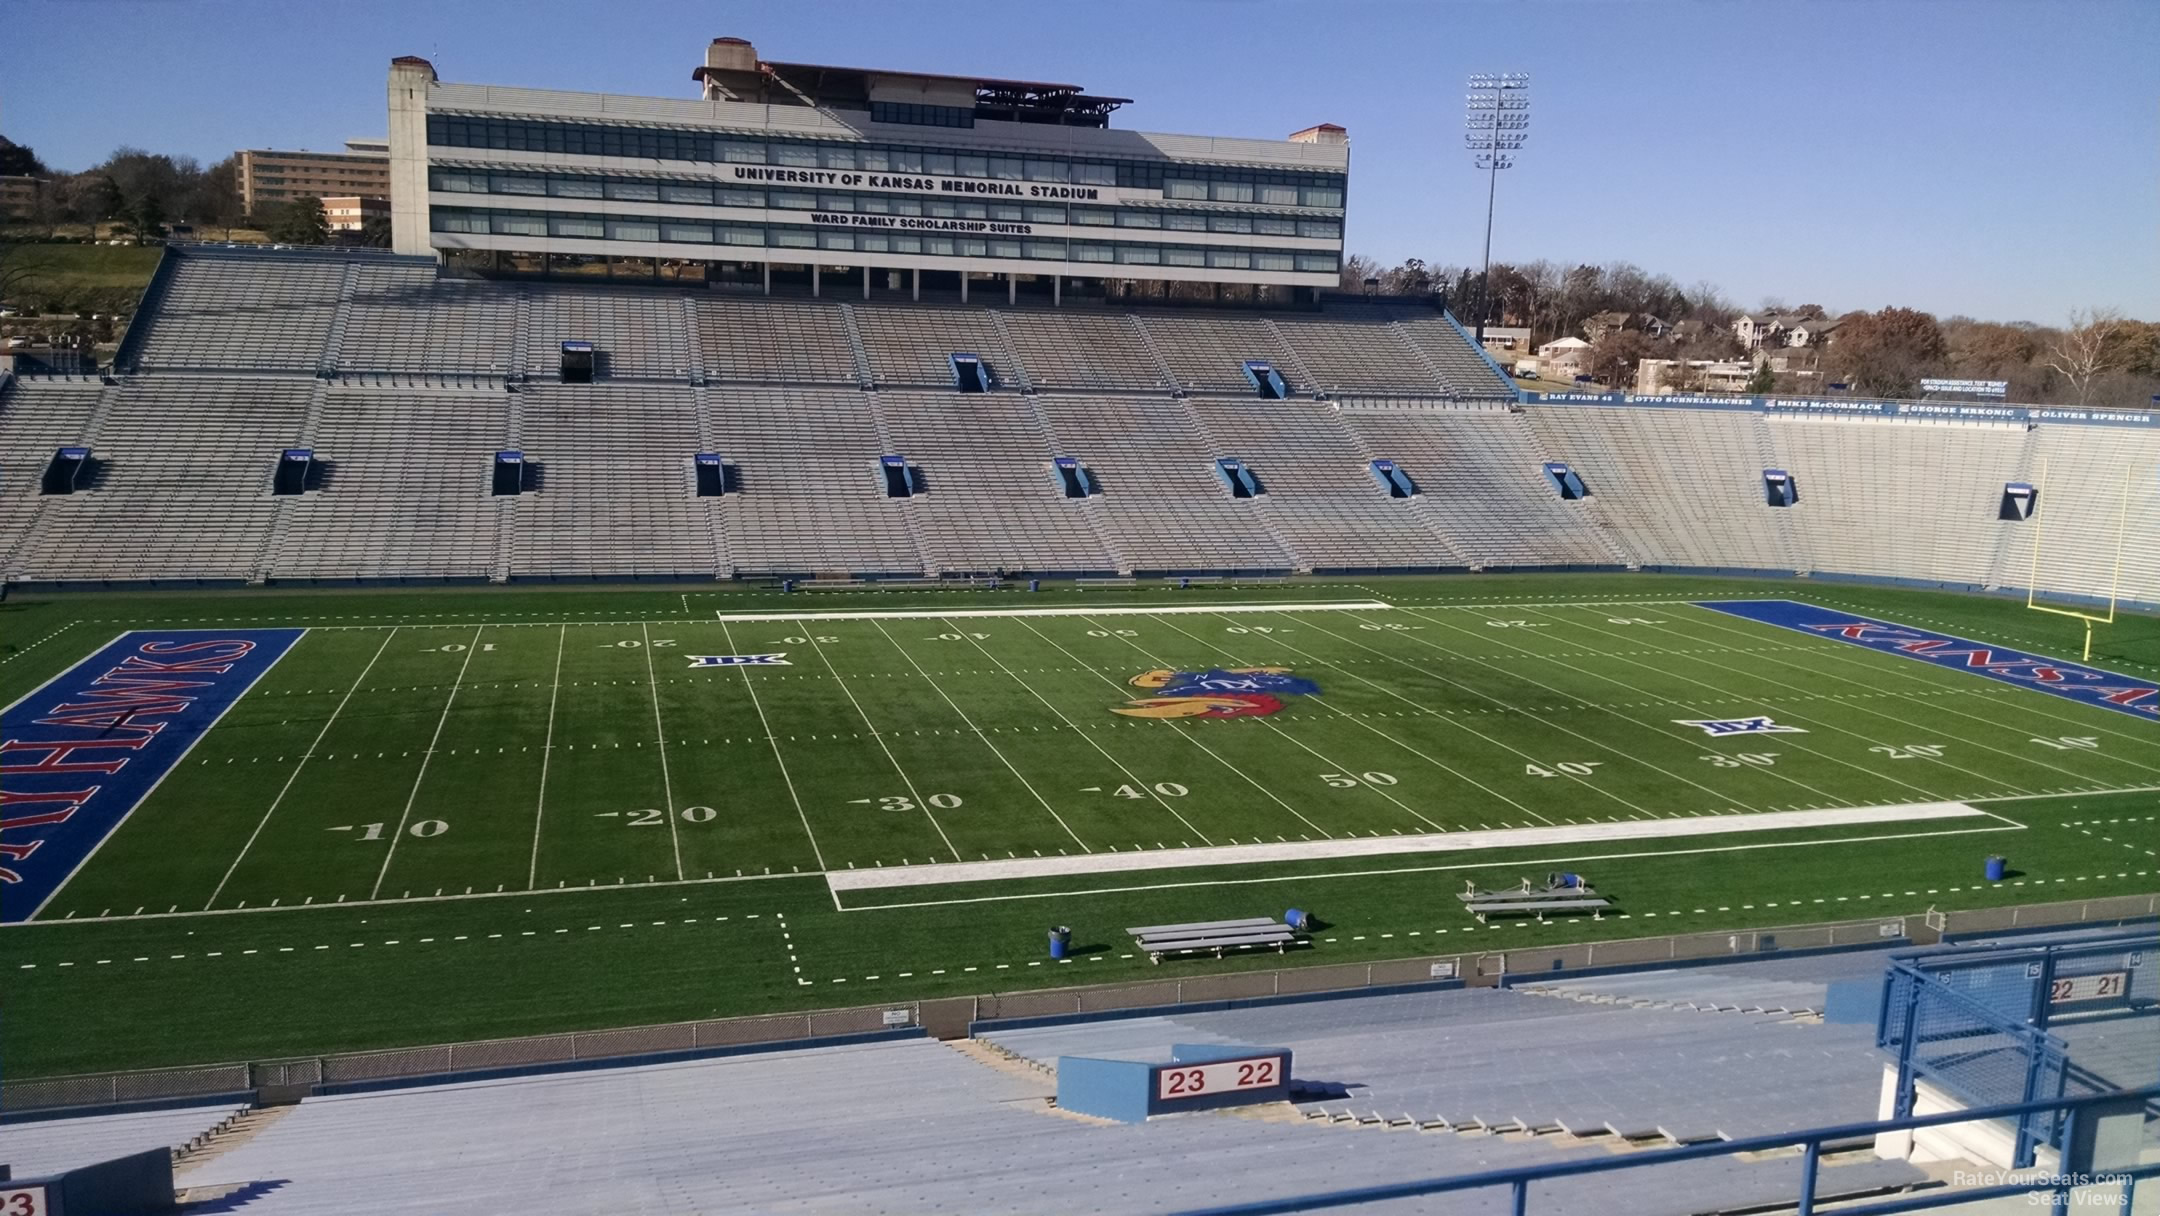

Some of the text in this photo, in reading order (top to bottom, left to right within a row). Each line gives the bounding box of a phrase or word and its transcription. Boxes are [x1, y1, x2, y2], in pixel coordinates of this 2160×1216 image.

[735, 167, 1099, 200] UNIVERSITY OF KANSAS MEMORIAL STADIUM
[811, 213, 1032, 234] WARD FAMILY SCHOLARSHIP SUITES
[1665, 396, 1753, 406] SCHNELLBACHER
[1777, 400, 1883, 410] MIKE McCORMACK
[1910, 405, 2015, 416] GEORGE MRKONIC
[2041, 411, 2151, 423] OLIVER SPENCER
[1800, 621, 2160, 713] KANSA
[1319, 771, 1399, 788] 50
[2029, 964, 2040, 975] 15
[2051, 976, 2120, 1000] 22 21
[1168, 1061, 1273, 1095] 23 22
